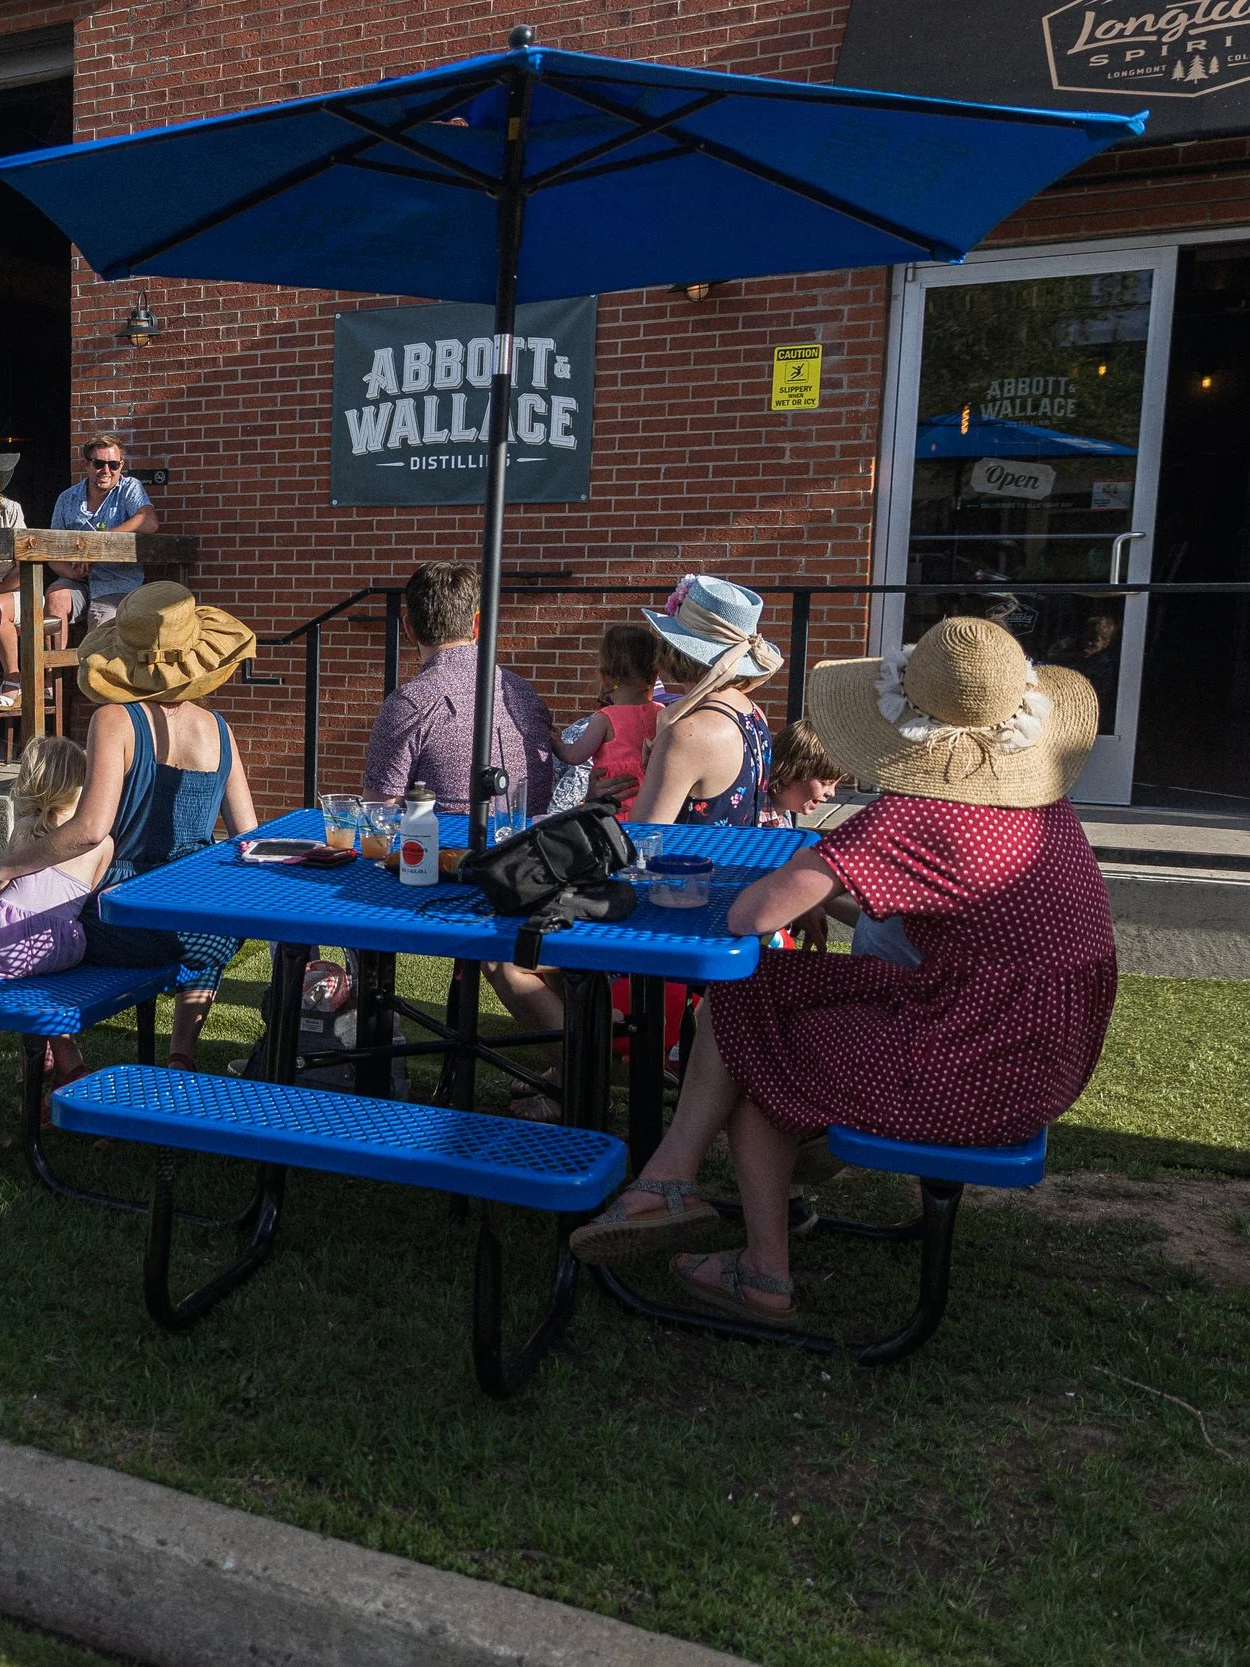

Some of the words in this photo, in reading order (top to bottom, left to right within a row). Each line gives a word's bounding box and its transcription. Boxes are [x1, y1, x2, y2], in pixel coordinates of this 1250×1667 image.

[1107, 64, 1167, 79] LONGMONT
[778, 348, 819, 360] CAUTION
[553, 355, 572, 380] &
[779, 385, 814, 394] SLIPPERY
[986, 376, 1069, 400] ABBOTT
[775, 399, 790, 407] WET
[792, 398, 802, 406] OR
[804, 397, 816, 405] ICY
[979, 397, 1078, 421] WALLACE
[985, 465, 1041, 491] Open
